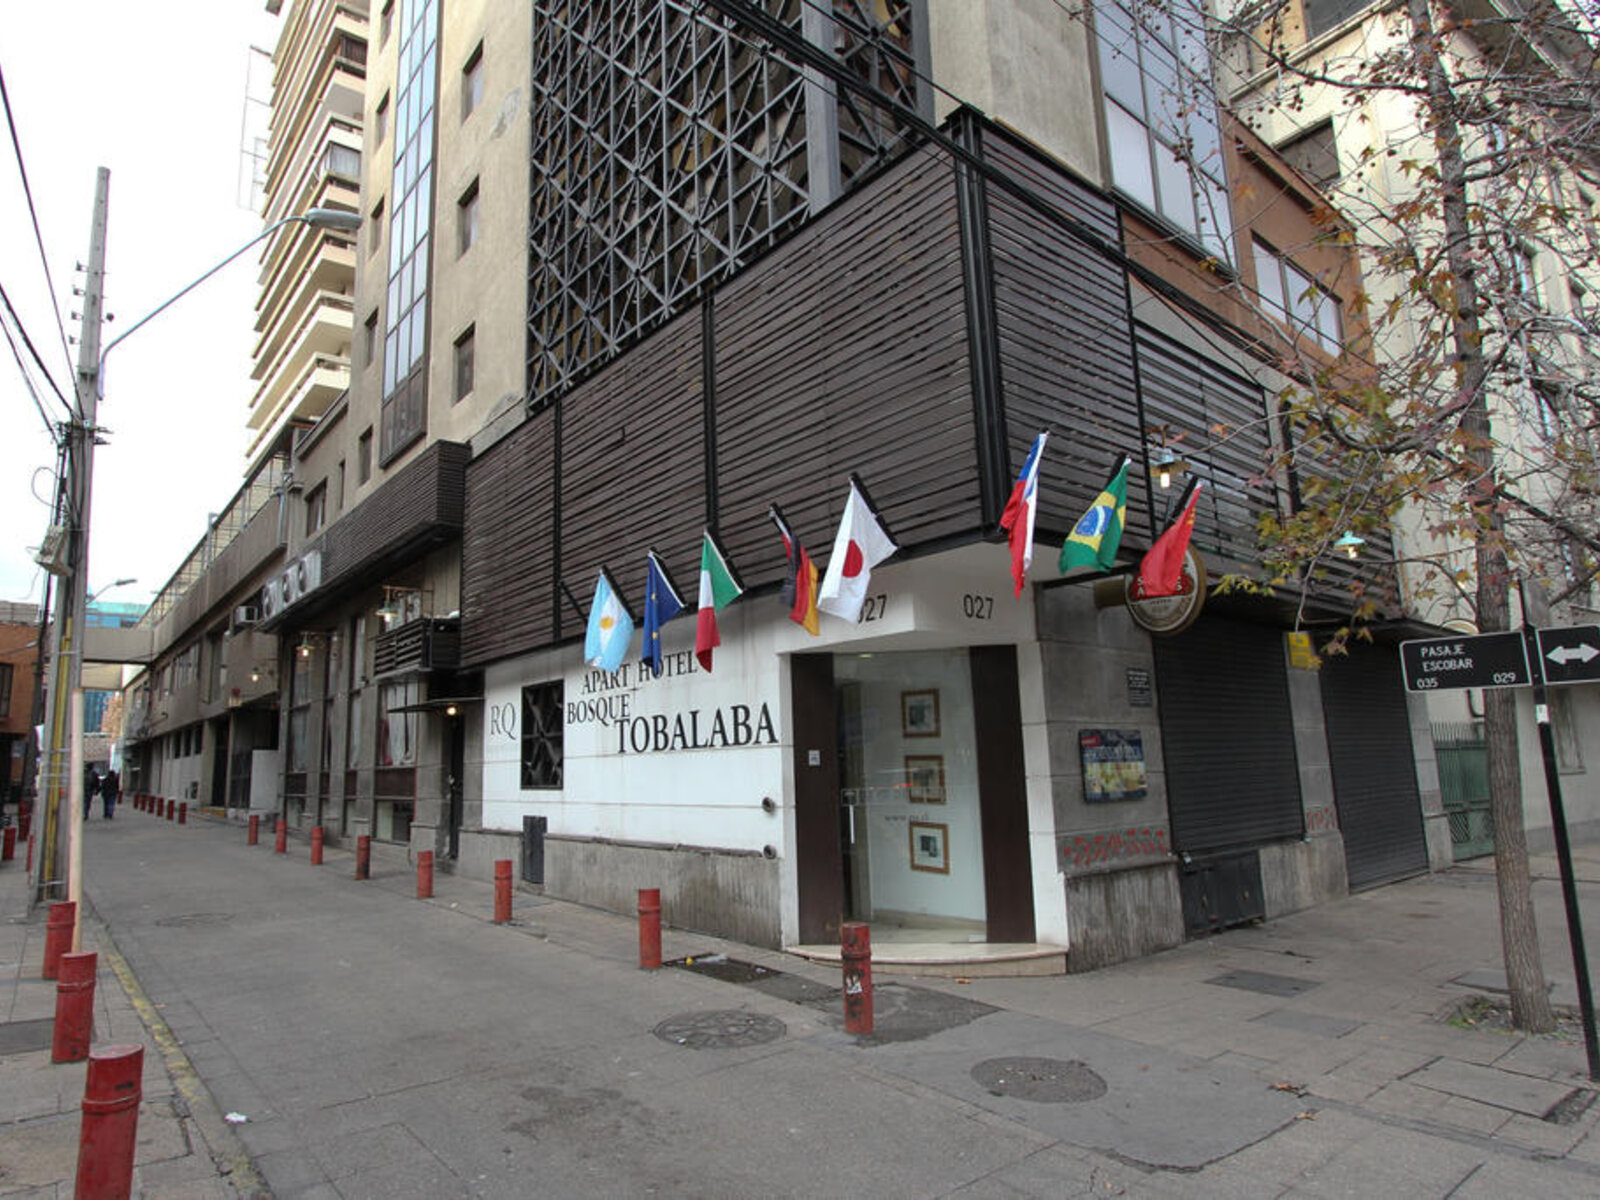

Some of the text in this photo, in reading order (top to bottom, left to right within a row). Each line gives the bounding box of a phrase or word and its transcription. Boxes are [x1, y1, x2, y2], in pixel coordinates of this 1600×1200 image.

[963, 594, 994, 619] 027
[1421, 644, 1465, 657] PASAJE
[1422, 658, 1474, 672] ESCOBAR
[1417, 678, 1439, 689] 035
[1493, 672, 1516, 685] 029
[567, 694, 631, 726] BOSQUE
[491, 702, 516, 740] RQ
[614, 702, 778, 753] TOBALABA
